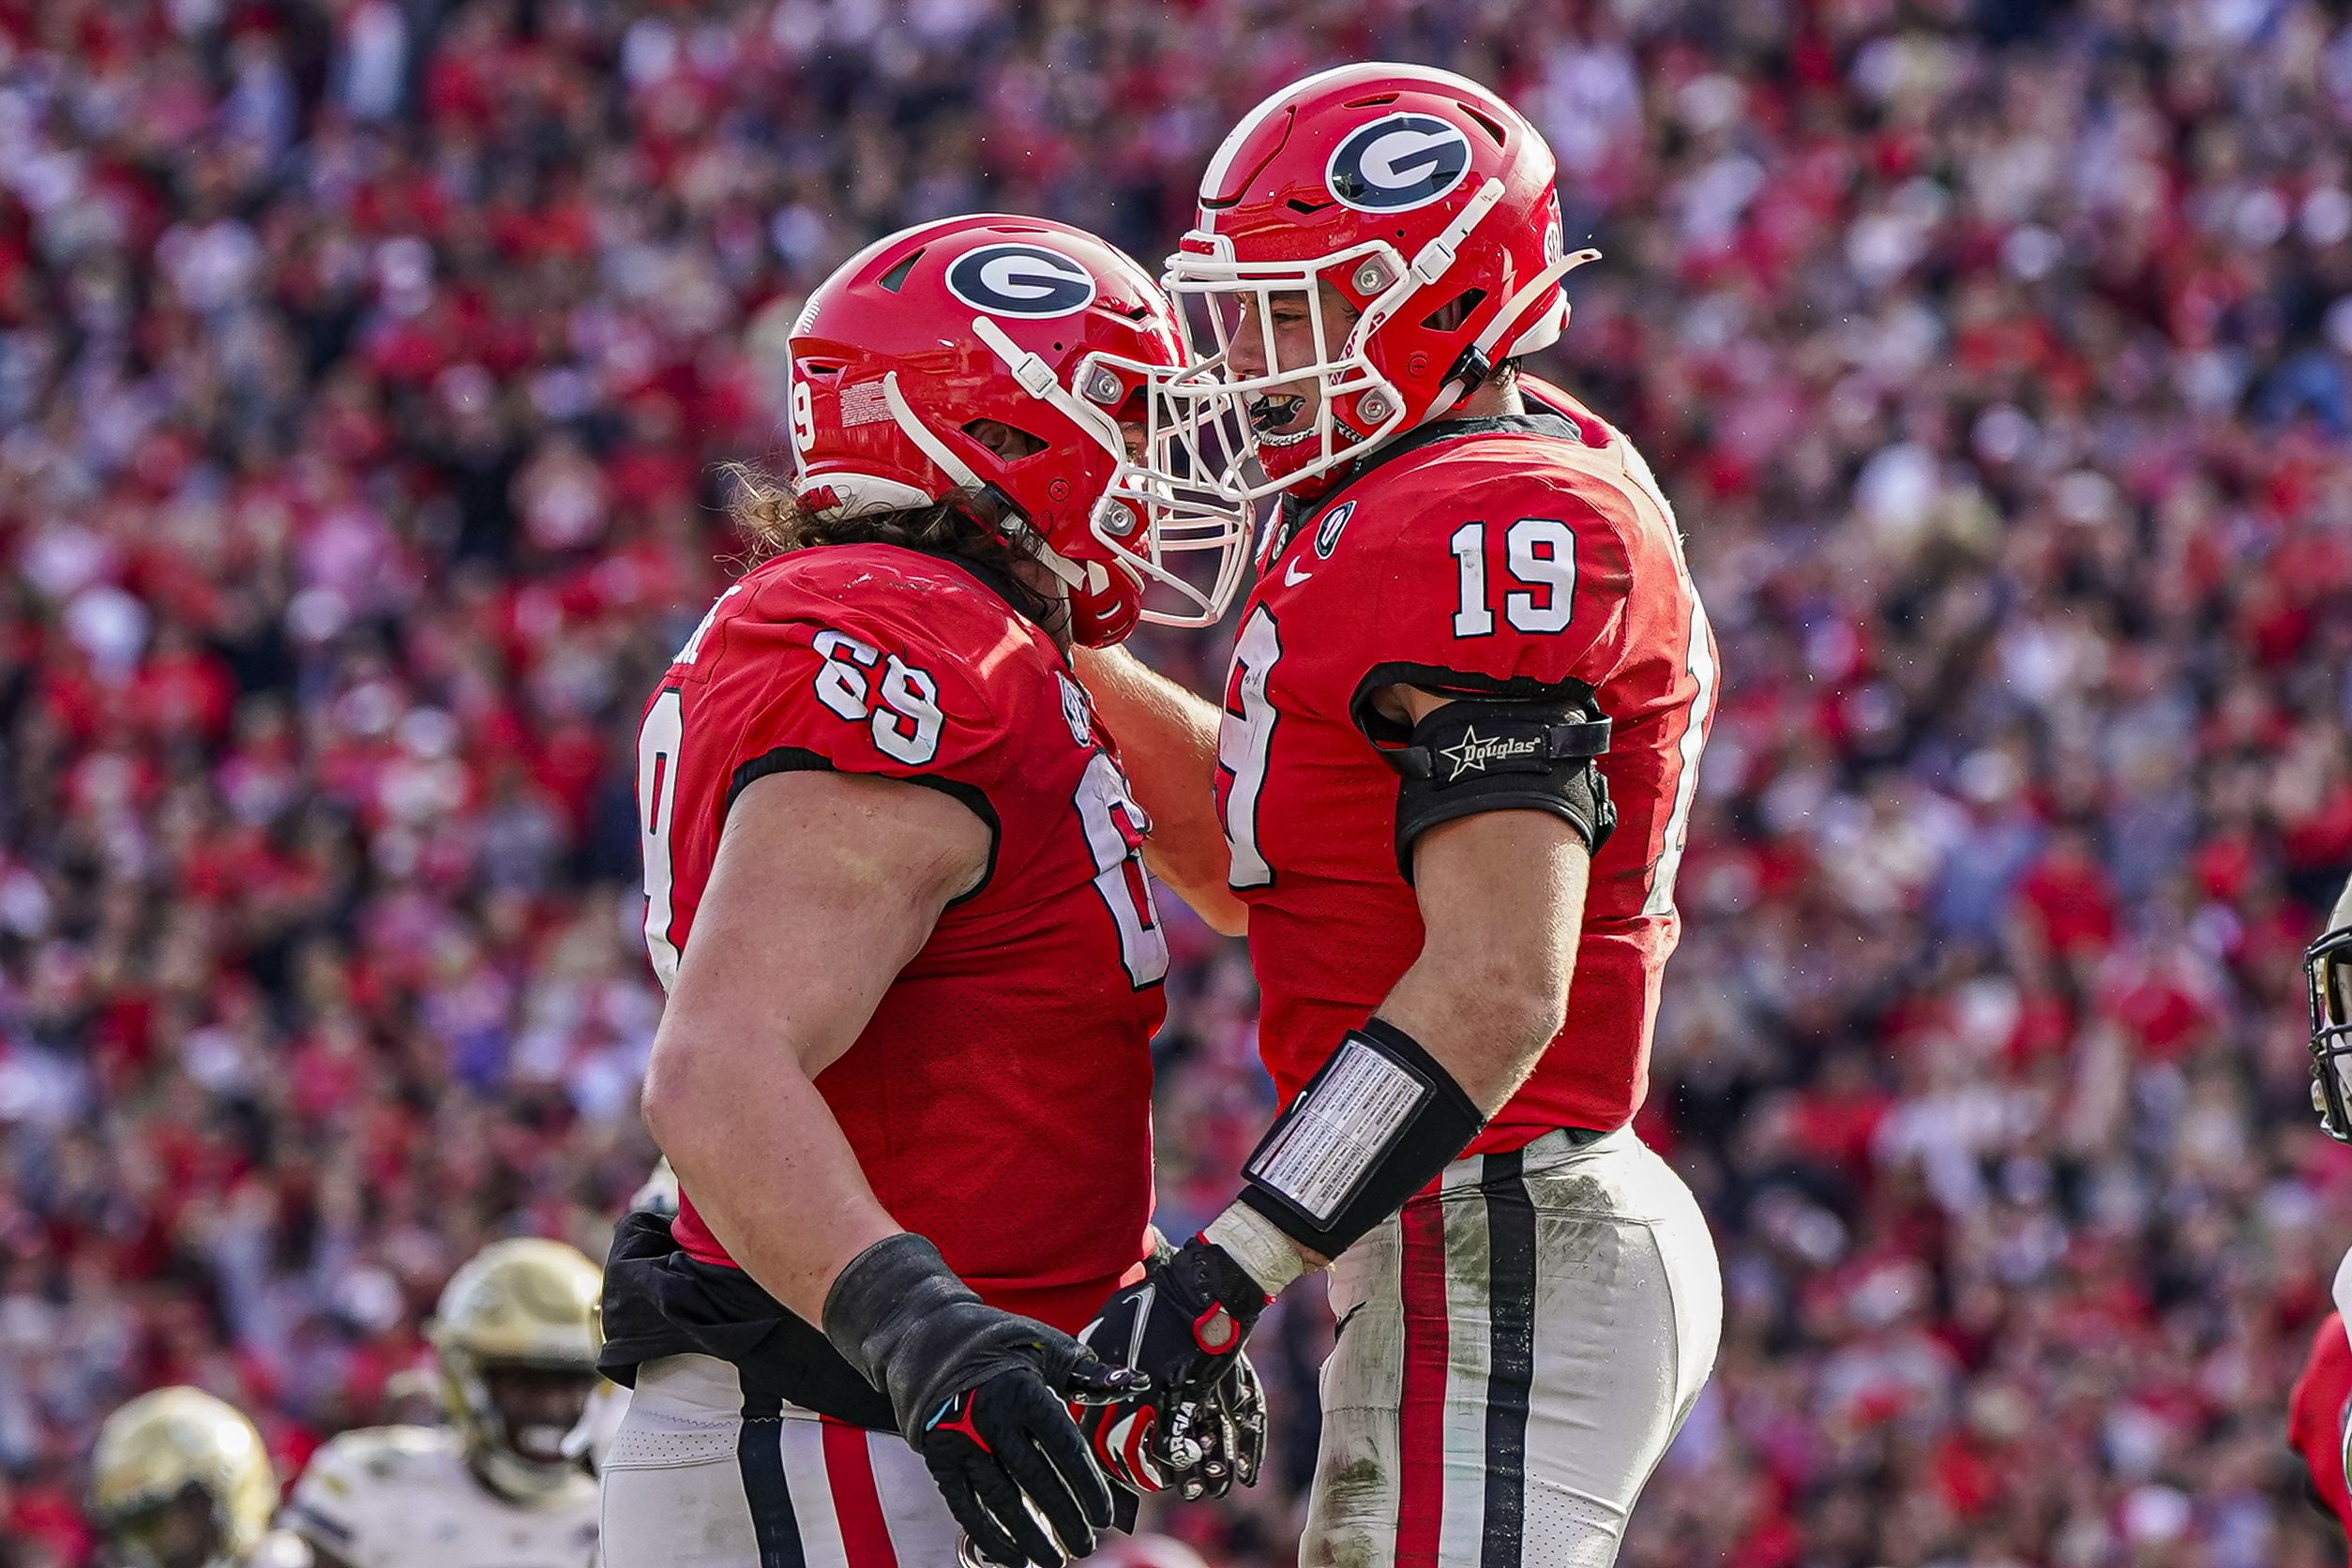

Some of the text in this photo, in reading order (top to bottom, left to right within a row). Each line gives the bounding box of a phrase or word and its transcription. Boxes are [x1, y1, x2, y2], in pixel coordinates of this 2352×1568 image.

[1450, 518, 1577, 639] 19
[810, 629, 943, 766] 69
[1463, 737, 1538, 762] Douglas
[1168, 1401, 1198, 1468] ORGIA
